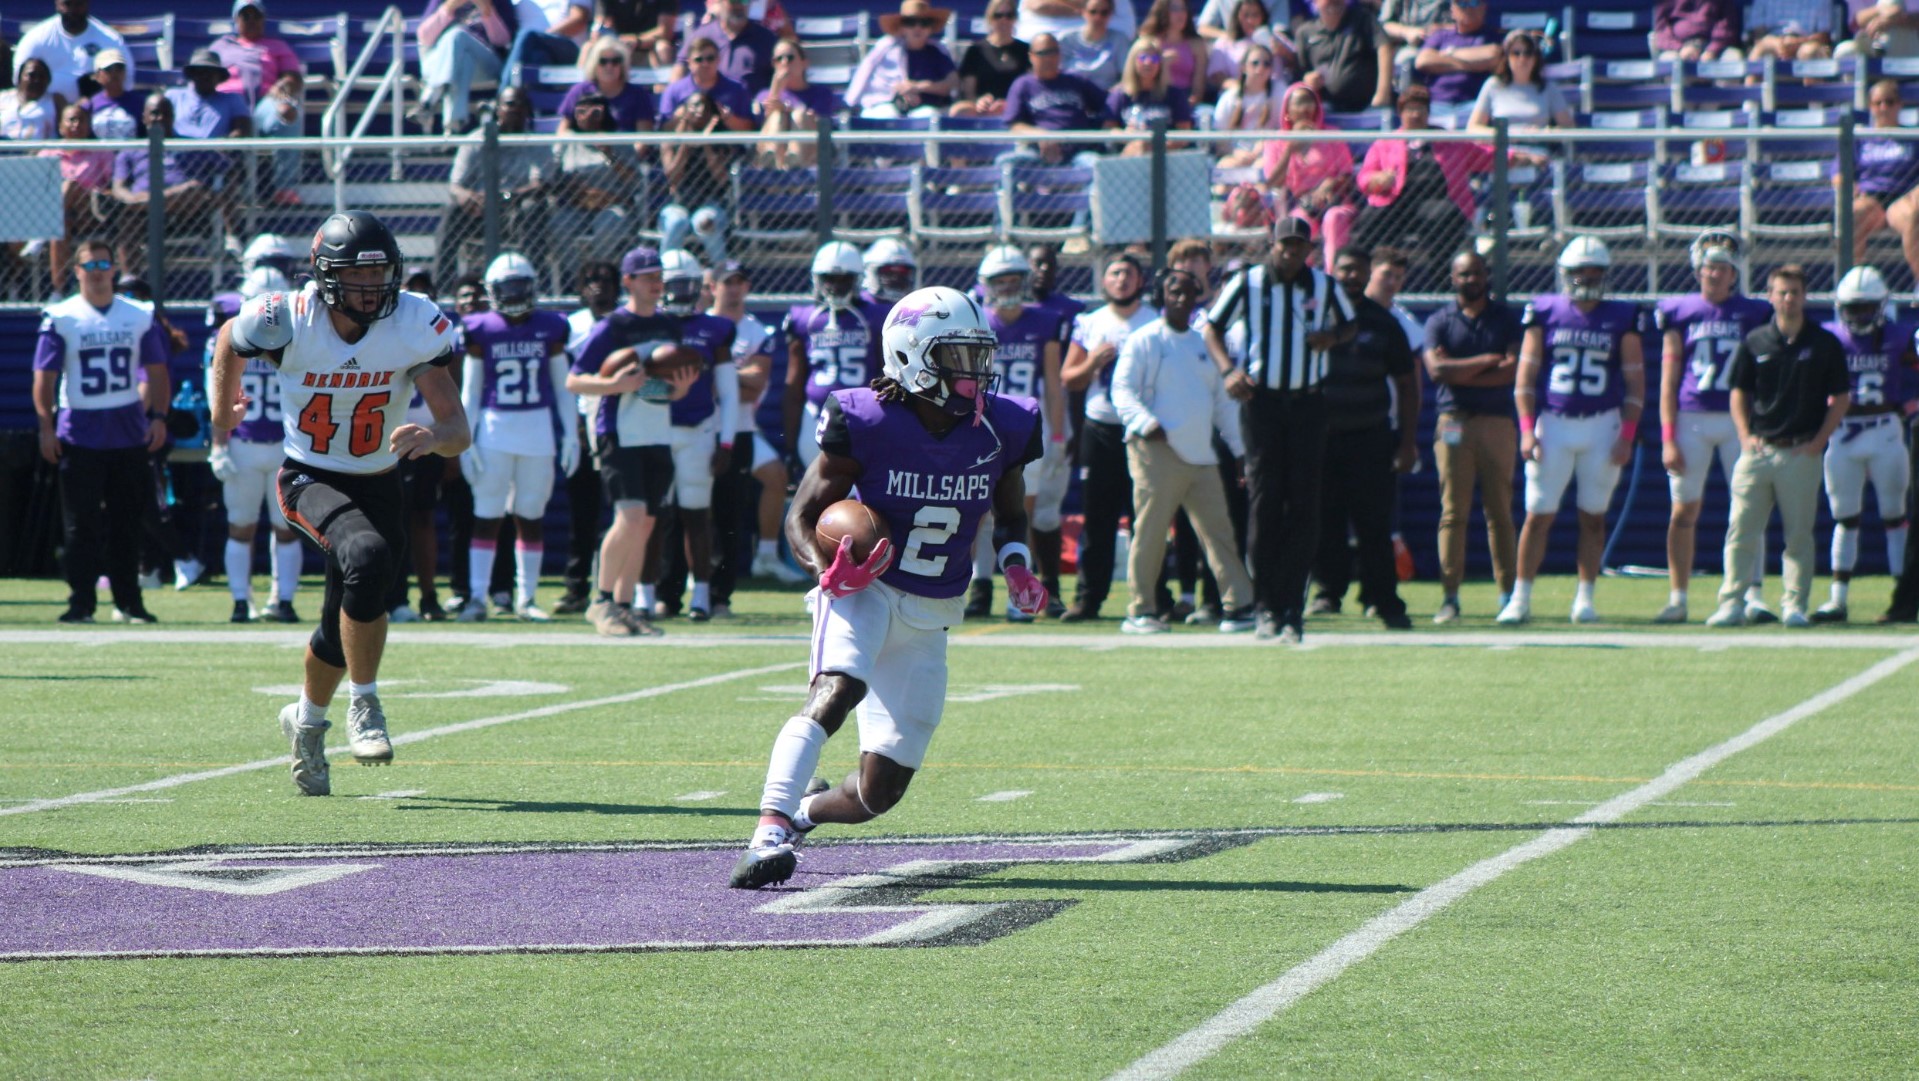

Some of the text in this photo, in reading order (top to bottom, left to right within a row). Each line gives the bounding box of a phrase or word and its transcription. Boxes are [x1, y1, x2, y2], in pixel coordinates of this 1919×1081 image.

[79, 332, 134, 348] MILLSAPS
[491, 342, 546, 359] MILLSAPS
[1552, 329, 1611, 349] MILLSAPS
[78, 347, 133, 396] 59
[302, 371, 396, 389] HENDRIX
[495, 359, 541, 405] 21
[808, 348, 867, 387] 35
[1549, 347, 1610, 396] 25
[1689, 339, 1741, 392] 47
[296, 390, 392, 458] 46
[885, 469, 990, 502] MILLSAPS
[898, 504, 962, 578] 2
